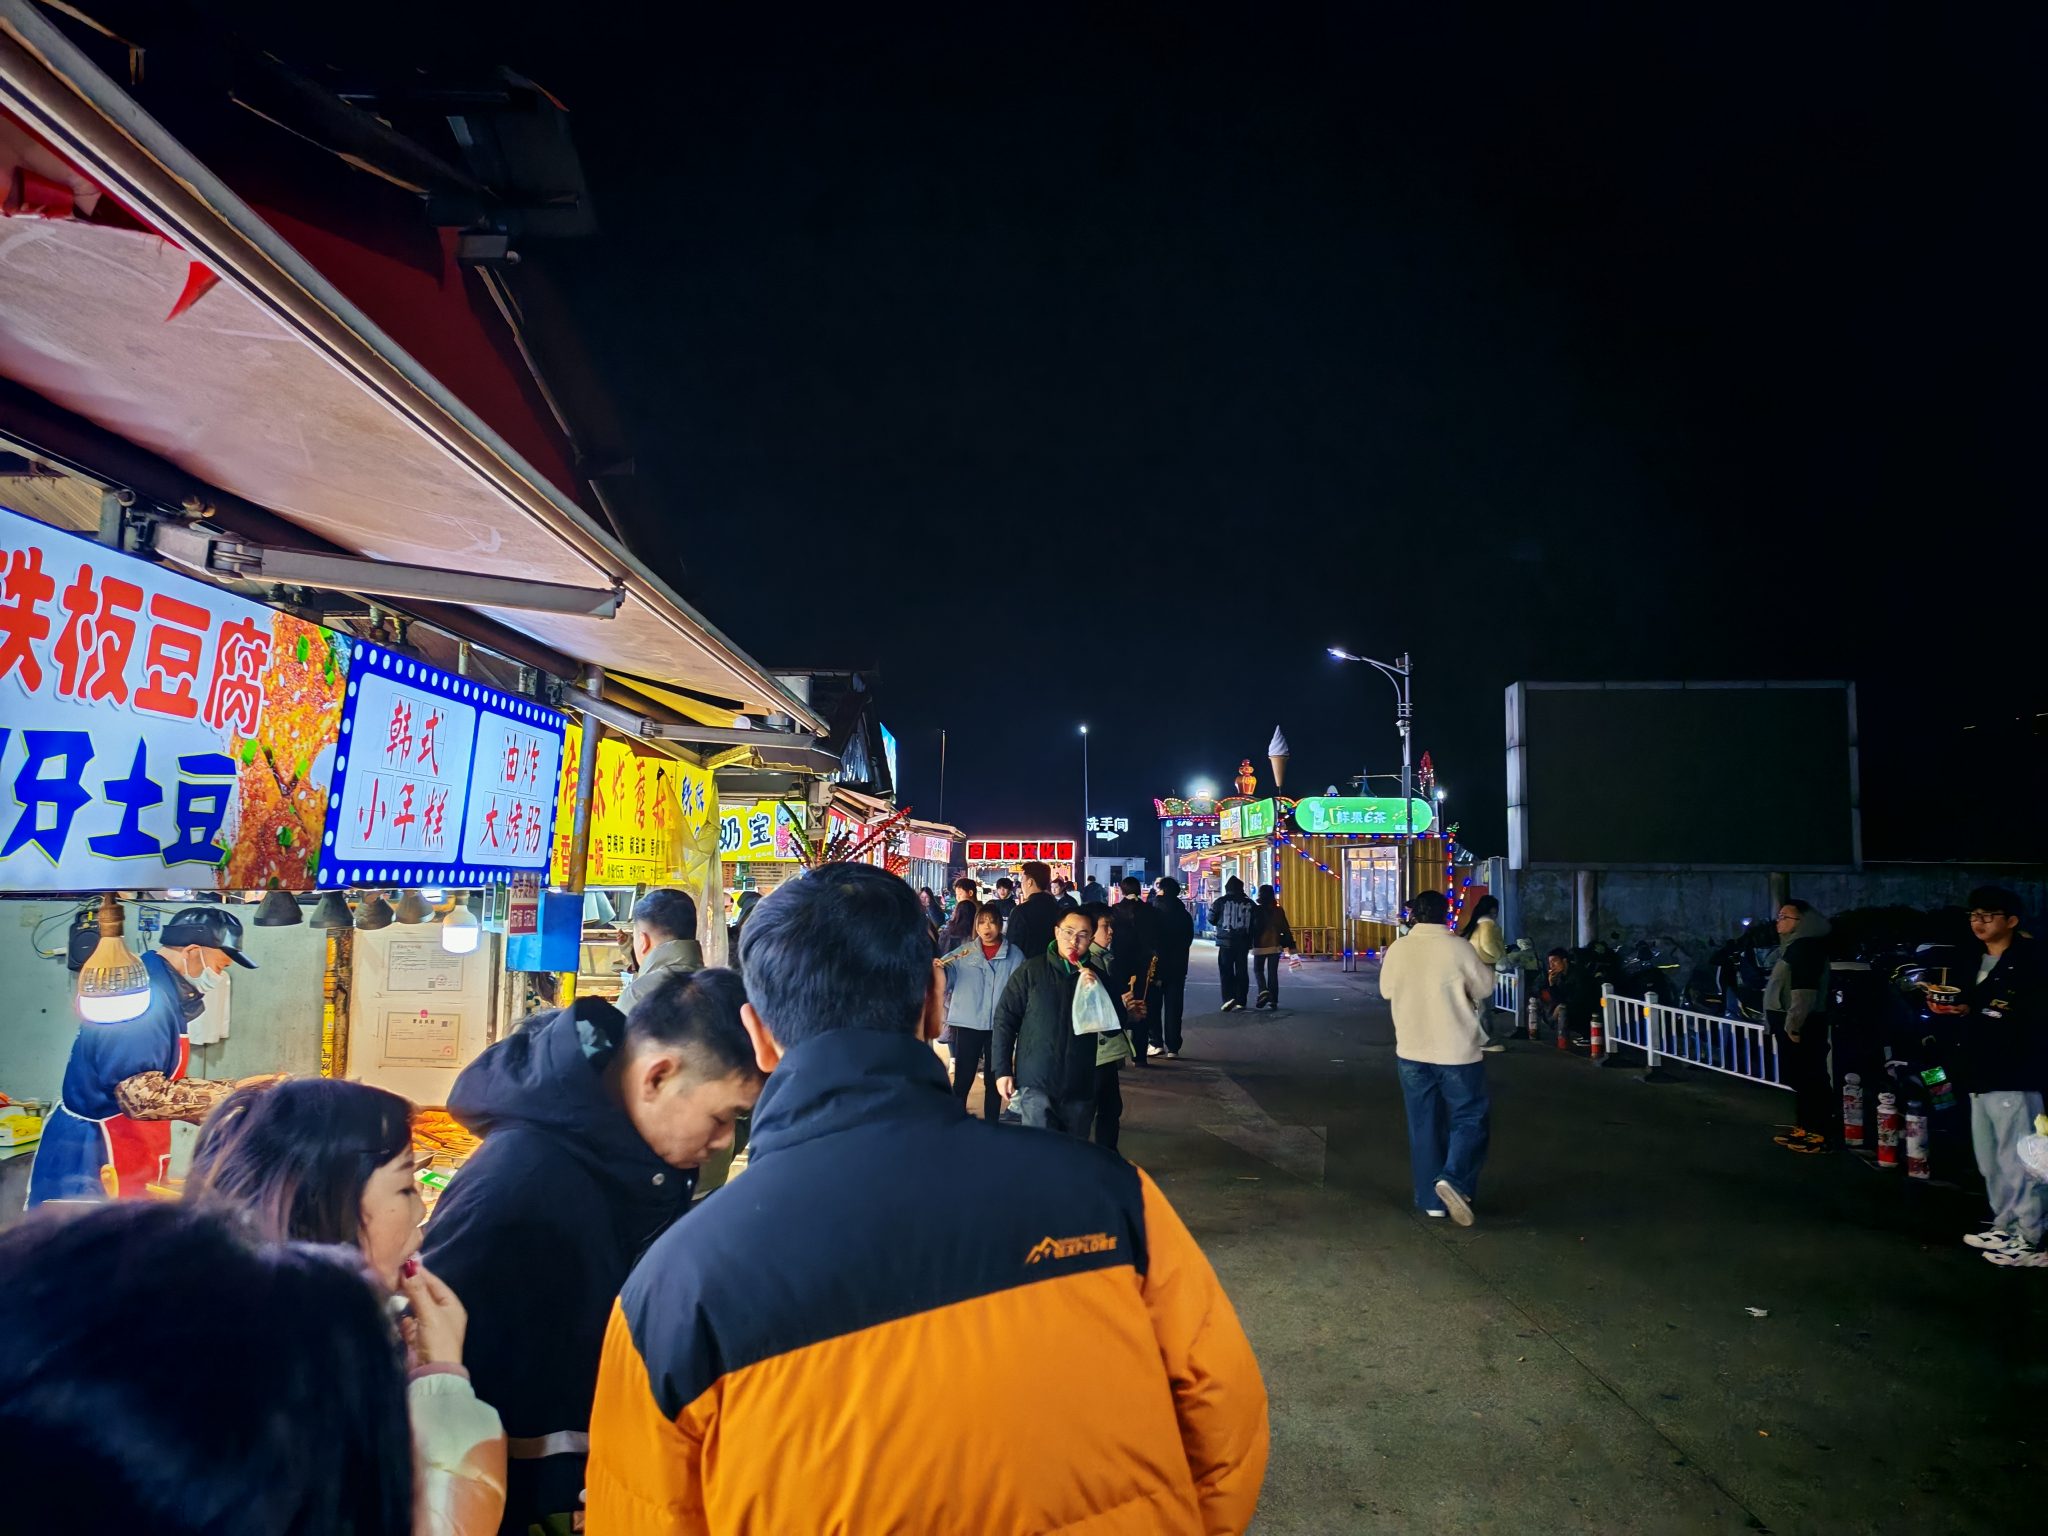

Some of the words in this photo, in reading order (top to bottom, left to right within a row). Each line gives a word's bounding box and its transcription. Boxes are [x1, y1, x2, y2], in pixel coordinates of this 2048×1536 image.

[386, 699, 445, 777] 韩式
[500, 732, 541, 793] 油炸
[359, 777, 449, 848] 小年糕
[480, 795, 542, 854] 大烤肠
[1086, 816, 1129, 833] 洗手间
